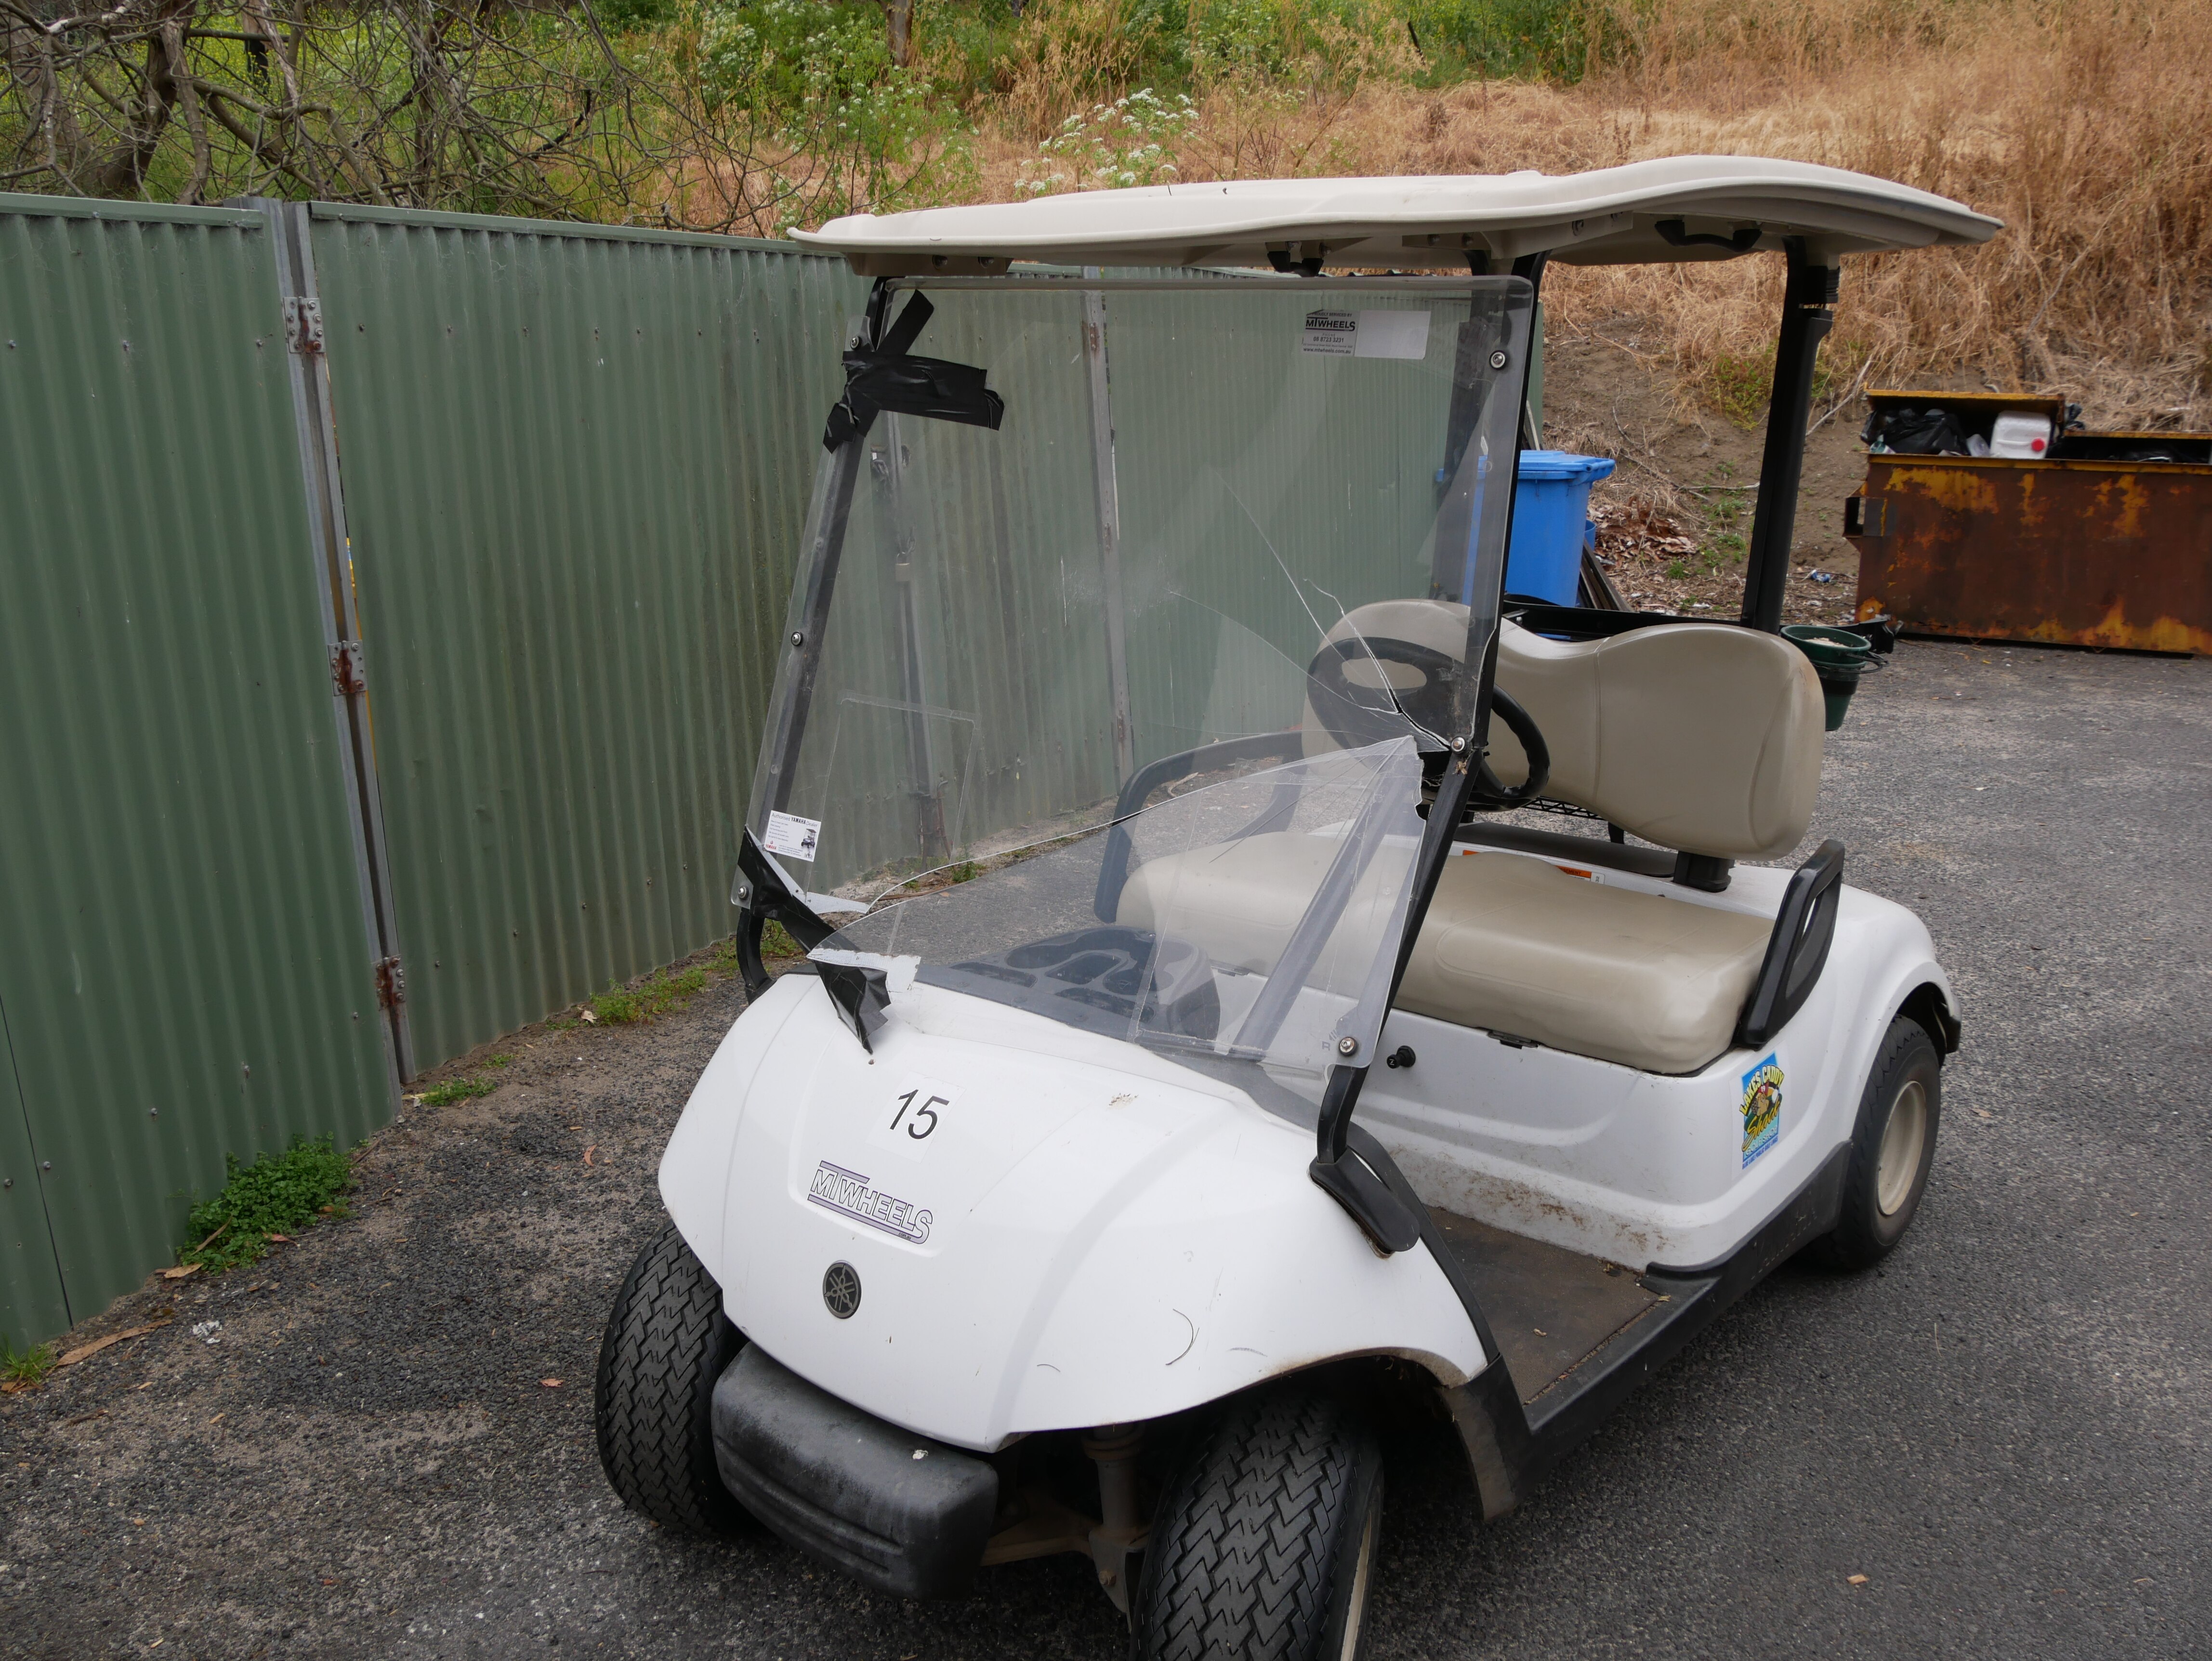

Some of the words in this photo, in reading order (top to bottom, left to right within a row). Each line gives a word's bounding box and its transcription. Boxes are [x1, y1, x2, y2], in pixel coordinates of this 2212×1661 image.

[1305, 317, 1356, 331] MTWHEELS
[1322, 1041, 1330, 1051] R
[1738, 1070, 1762, 1117] LAKES
[1762, 1064, 1784, 1088] CADDY
[889, 1089, 950, 1140] 15
[1762, 1126, 1778, 1143] SHOP
[1755, 1147, 1764, 1159] PUBLIC
[807, 1160, 933, 1244] MTWHEELS
